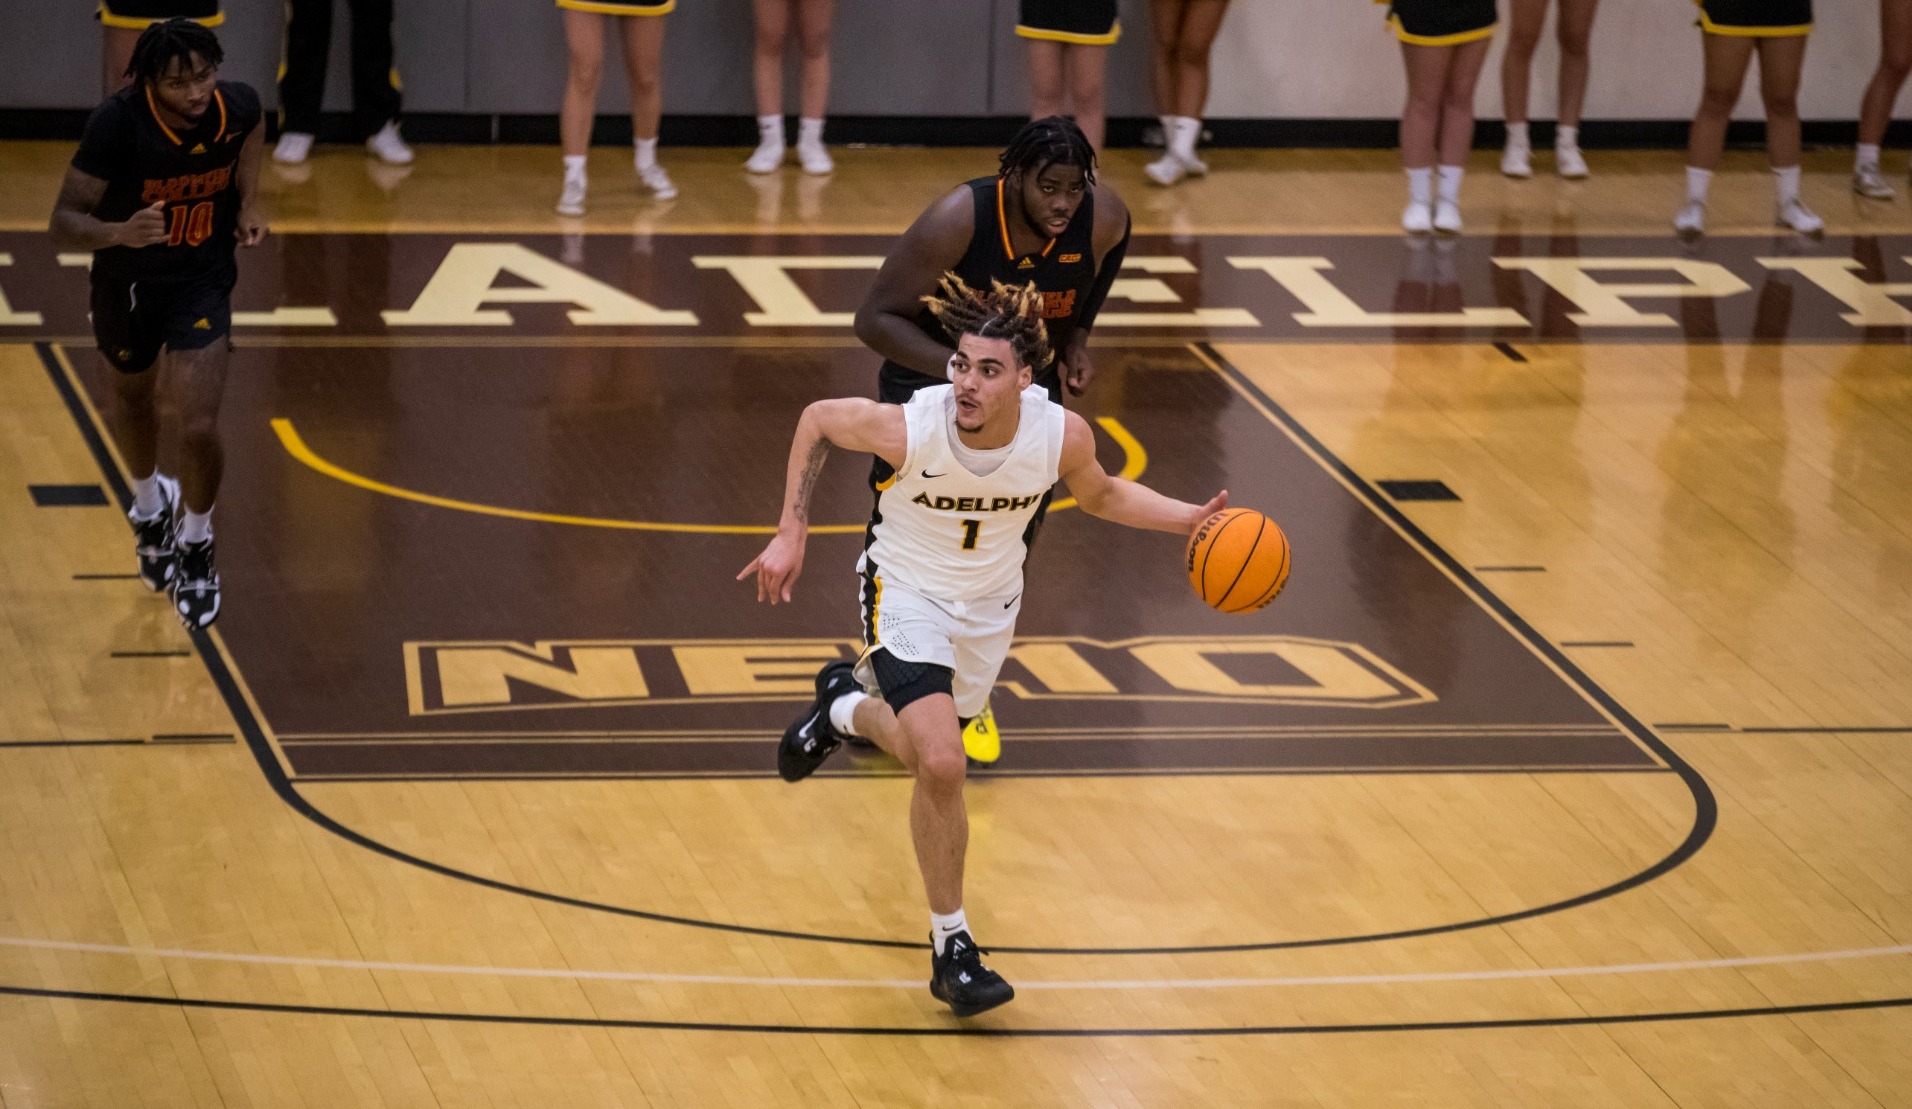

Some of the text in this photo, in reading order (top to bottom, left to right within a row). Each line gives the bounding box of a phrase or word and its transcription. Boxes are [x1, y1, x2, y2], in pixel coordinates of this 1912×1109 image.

[169, 202, 213, 247] 10
[911, 491, 1040, 511] ADELPHI
[960, 518, 983, 551] 1
